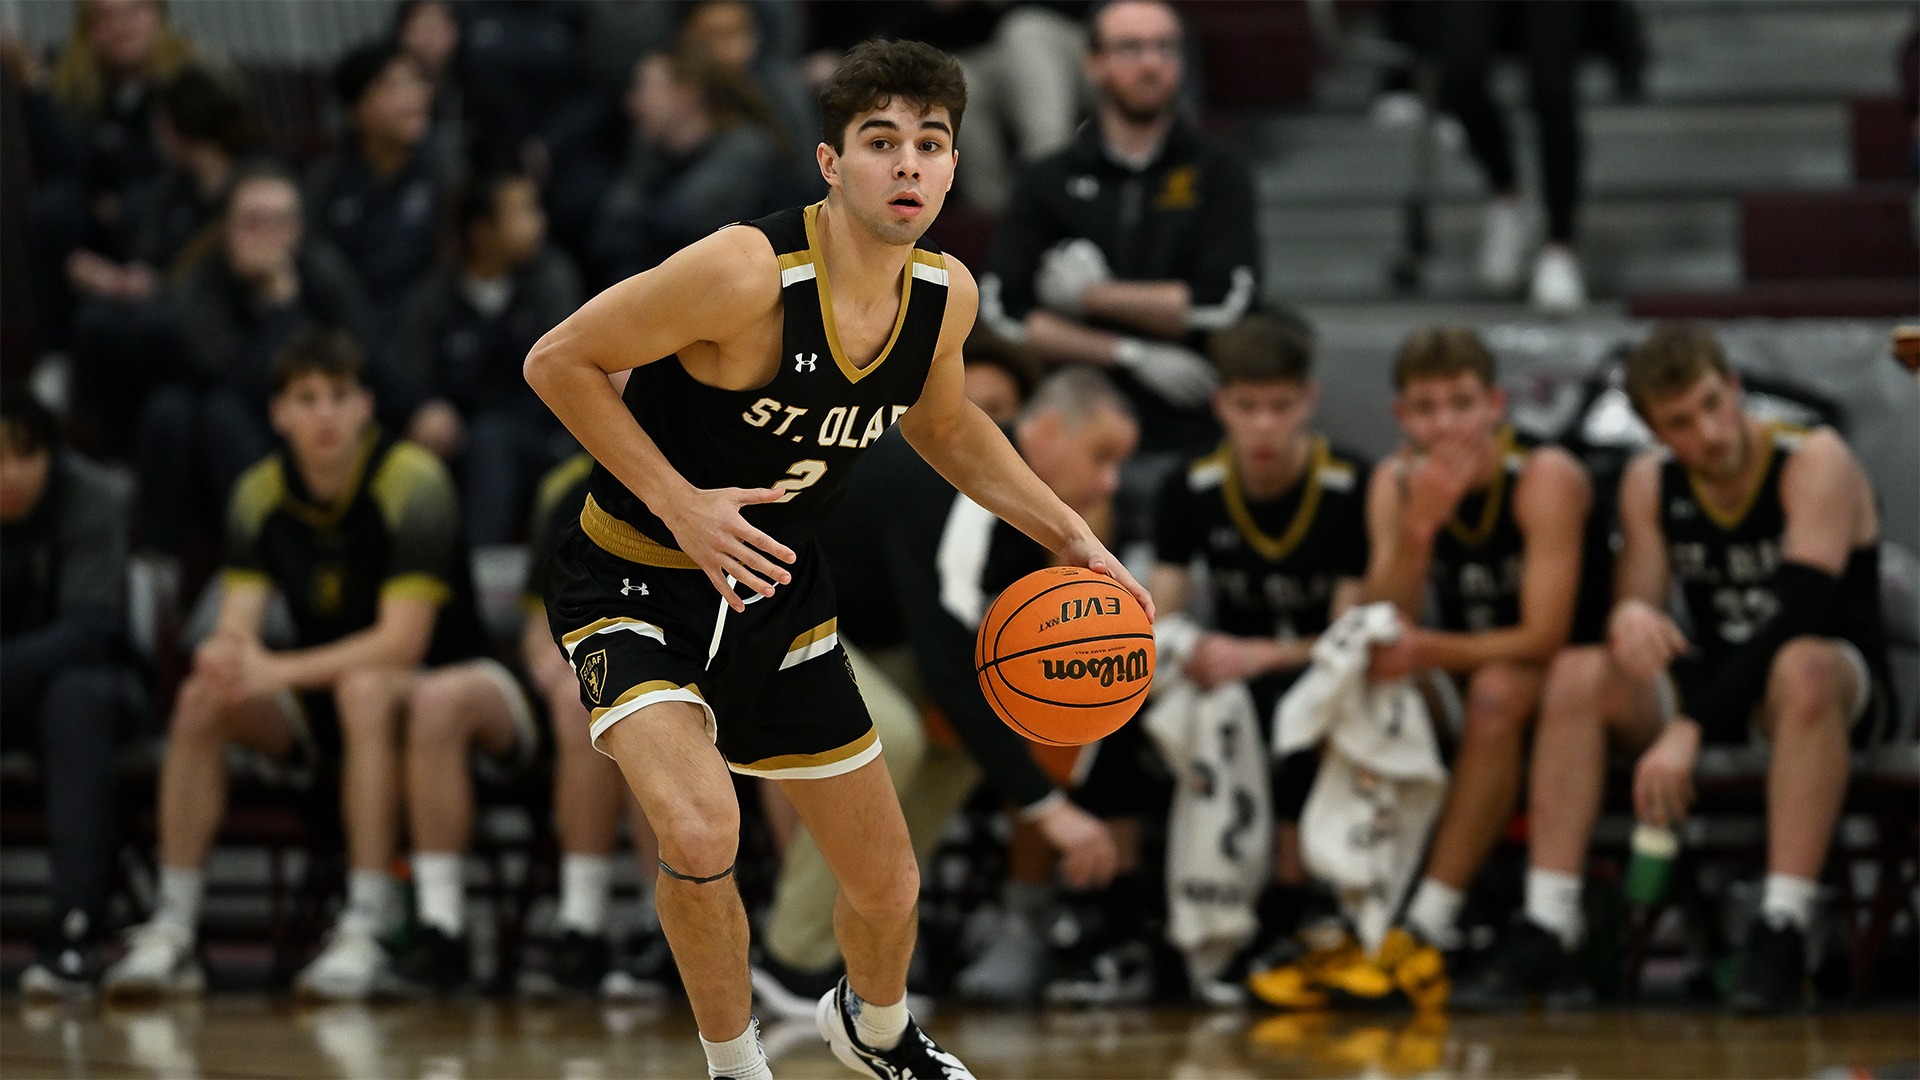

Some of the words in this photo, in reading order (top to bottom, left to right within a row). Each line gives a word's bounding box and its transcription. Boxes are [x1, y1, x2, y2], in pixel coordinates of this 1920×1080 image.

[741, 397, 809, 443] ST.
[771, 458, 828, 502] 2
[1038, 617, 1060, 633] NXT
[1042, 648, 1149, 688] Wilson
